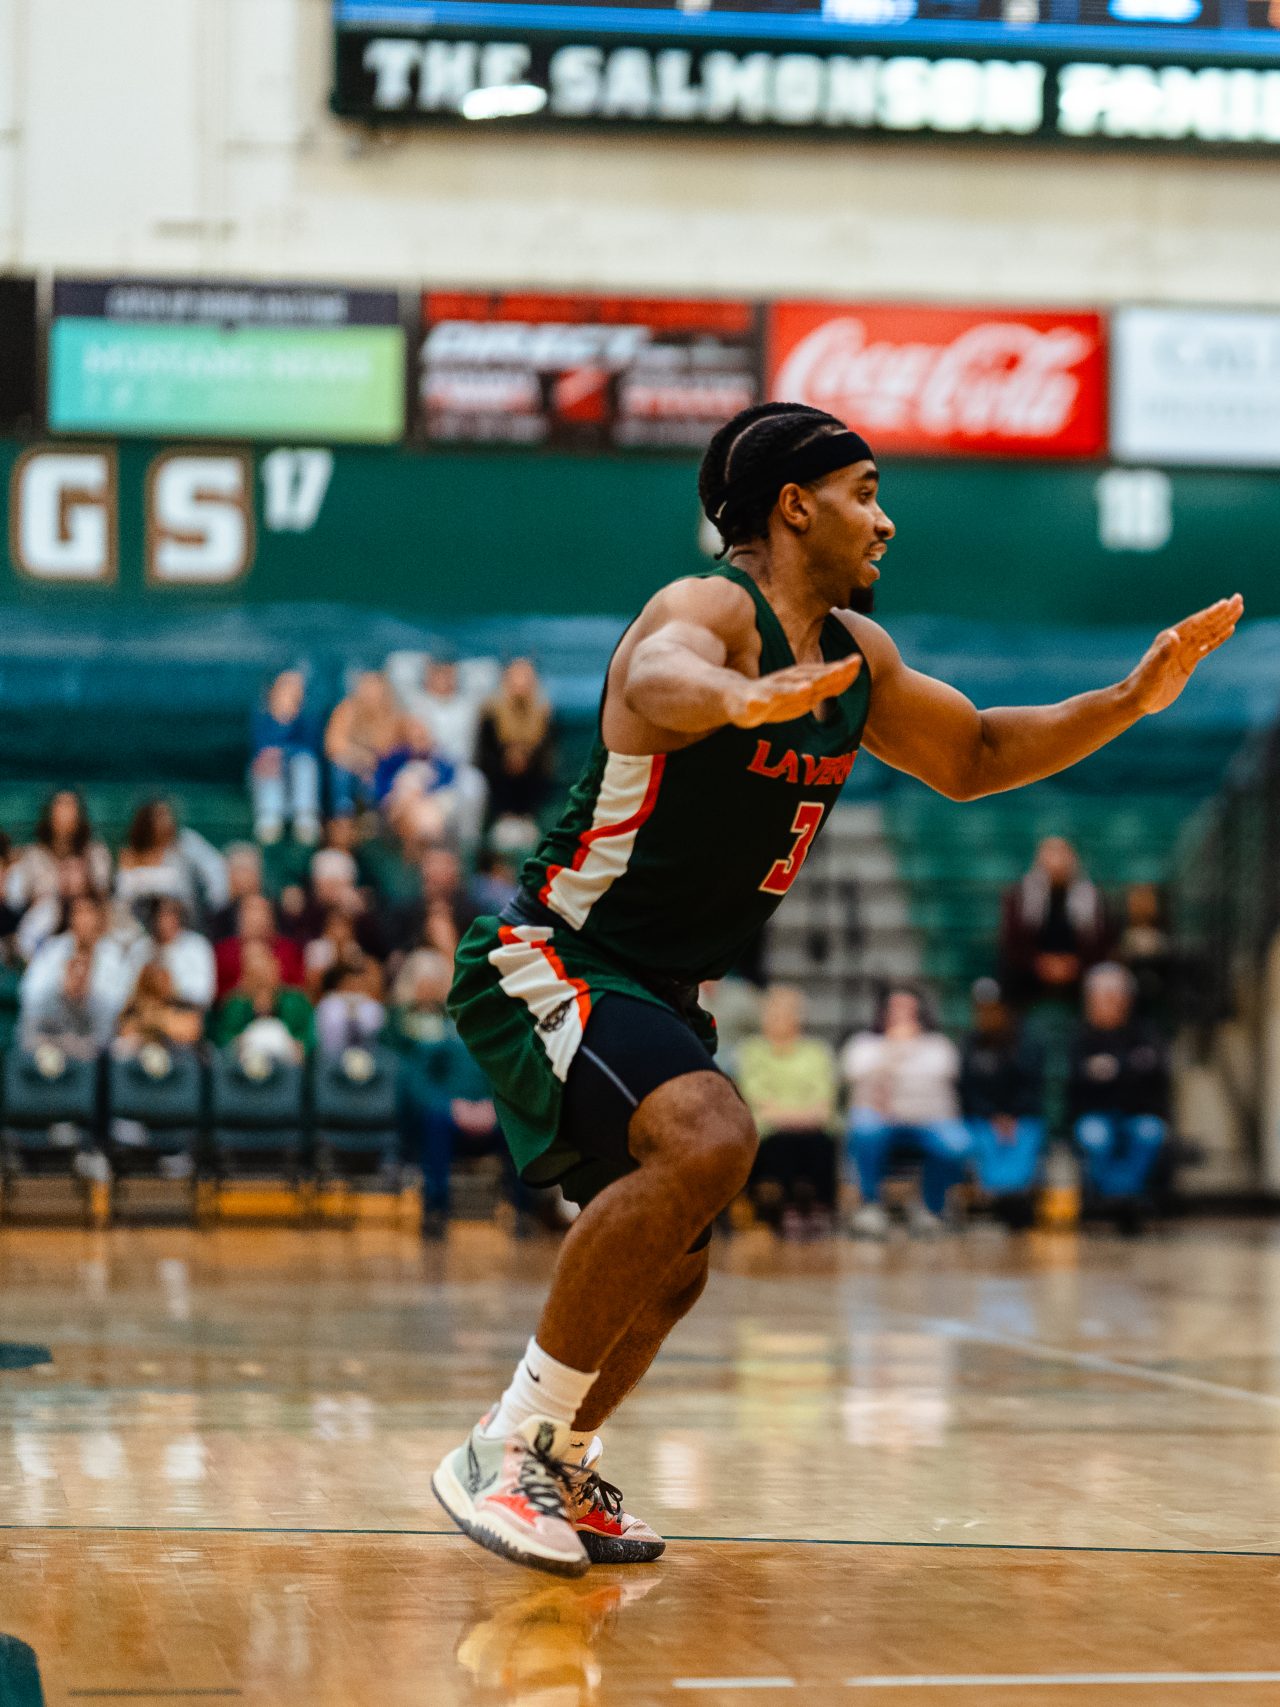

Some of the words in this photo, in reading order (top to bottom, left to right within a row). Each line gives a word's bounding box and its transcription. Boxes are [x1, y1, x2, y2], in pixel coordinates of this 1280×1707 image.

[366, 40, 533, 111] THE
[548, 45, 1045, 132] SALMONSON
[261, 448, 335, 532] 17
[758, 801, 825, 896] 3
